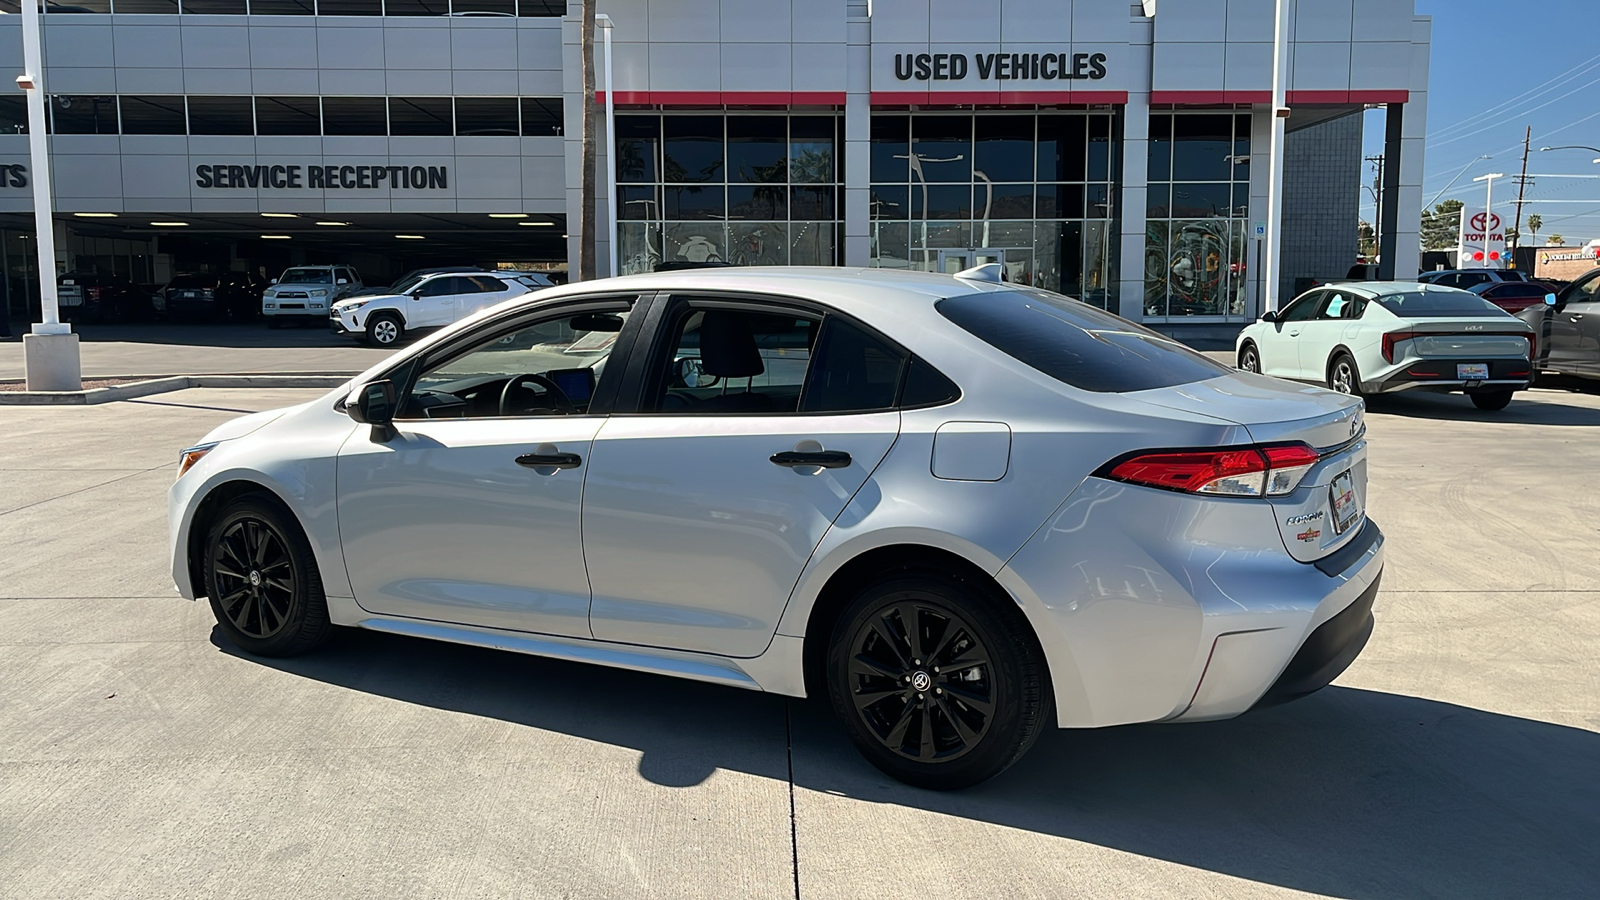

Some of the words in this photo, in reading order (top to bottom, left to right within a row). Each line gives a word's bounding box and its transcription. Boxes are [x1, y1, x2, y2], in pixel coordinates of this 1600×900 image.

[895, 53, 968, 81] USED
[975, 53, 1107, 81] VEHICLES
[195, 164, 302, 189] SERVICE
[307, 165, 448, 190] RECEPTION
